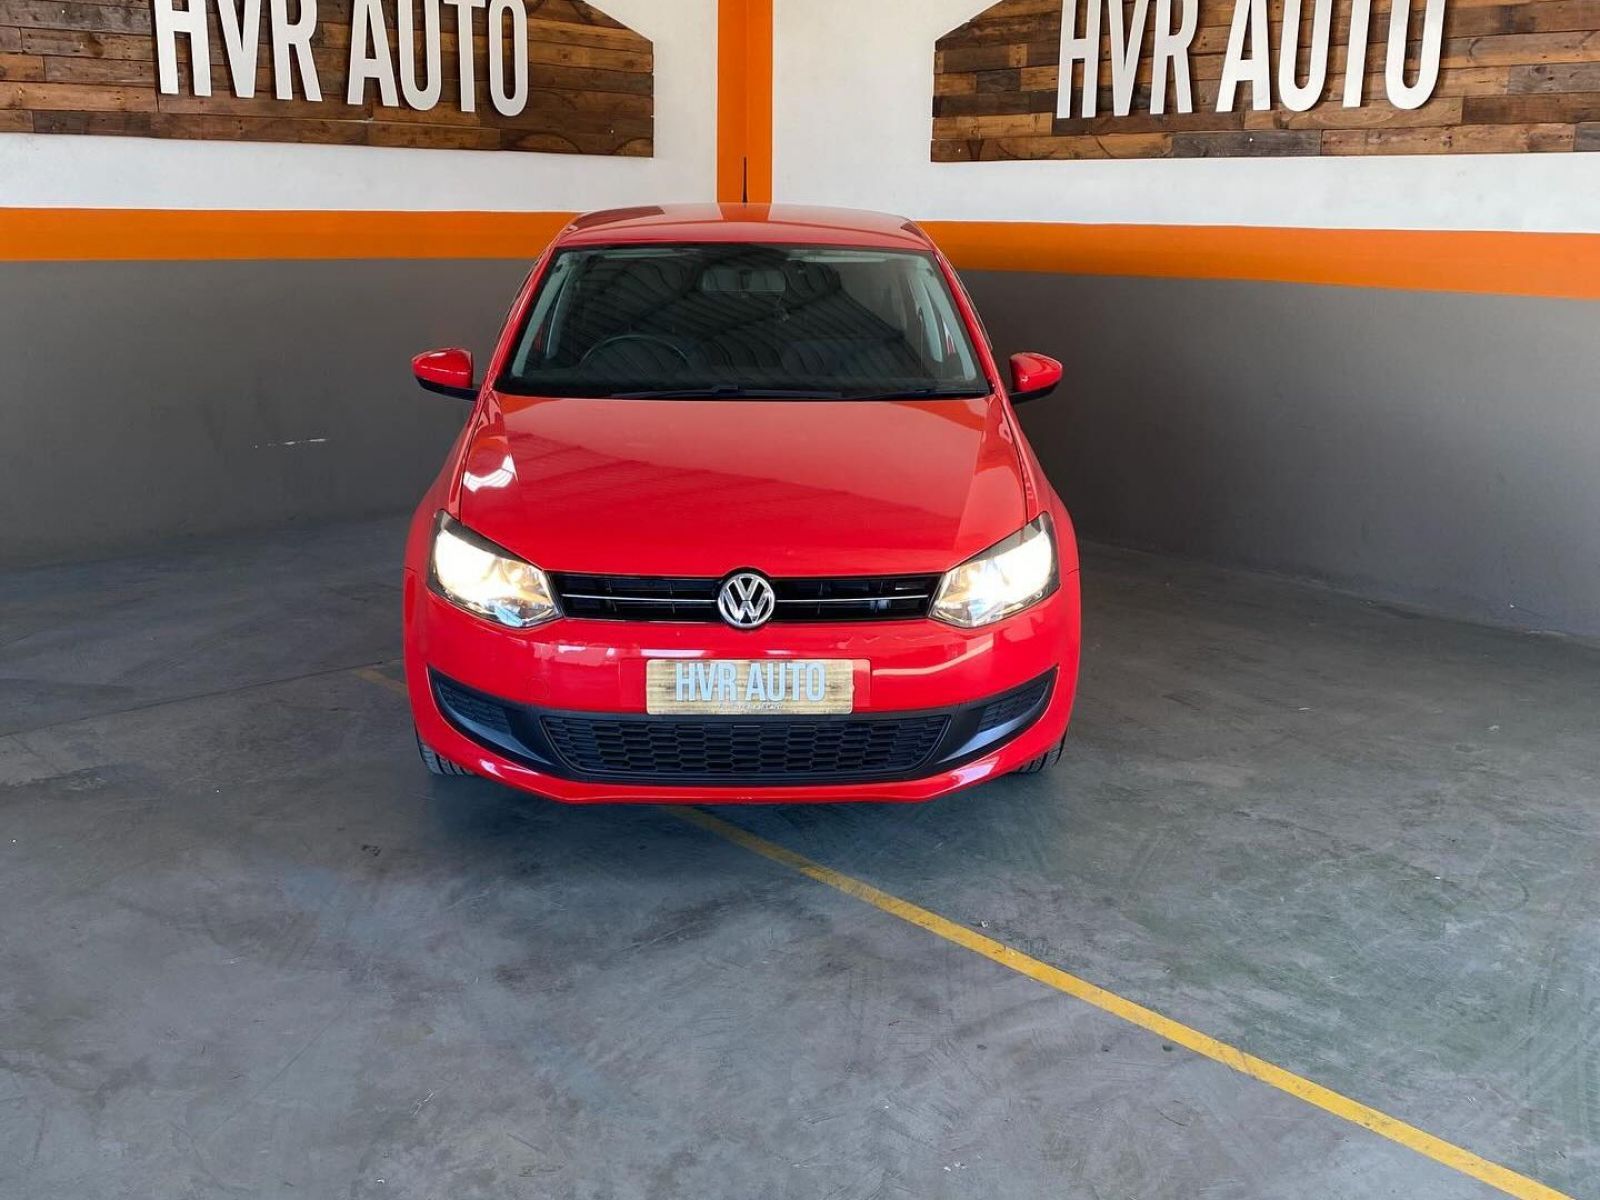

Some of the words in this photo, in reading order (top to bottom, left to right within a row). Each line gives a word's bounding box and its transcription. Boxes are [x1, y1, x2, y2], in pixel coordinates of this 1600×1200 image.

[154, 0, 322, 102] HVR
[347, 0, 529, 117] AUTO
[1056, 0, 1199, 119] HVR
[676, 662, 737, 701] HVR
[746, 662, 826, 701] AUTO
